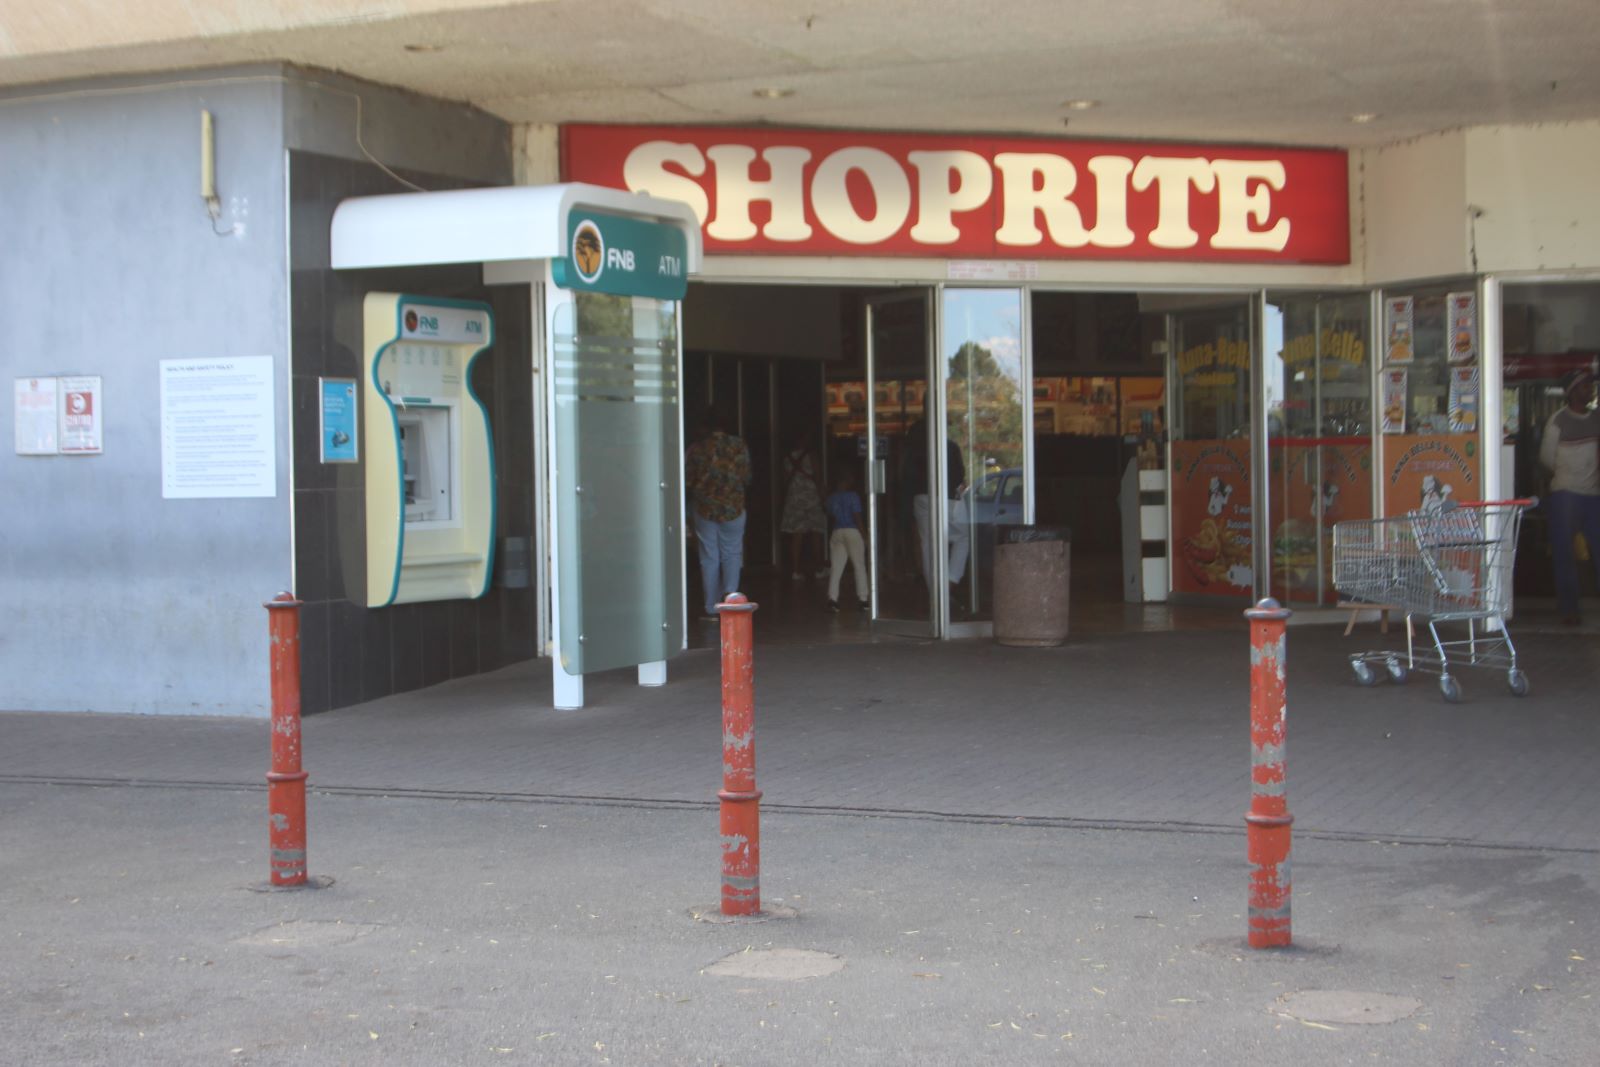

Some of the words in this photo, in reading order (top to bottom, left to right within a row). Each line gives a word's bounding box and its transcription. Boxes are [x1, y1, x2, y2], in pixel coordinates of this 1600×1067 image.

[623, 140, 1291, 252] SHOPRITE
[607, 247, 636, 272] FNB
[658, 255, 681, 277] ATM
[419, 315, 439, 331] FNB
[464, 319, 482, 334] ATM
